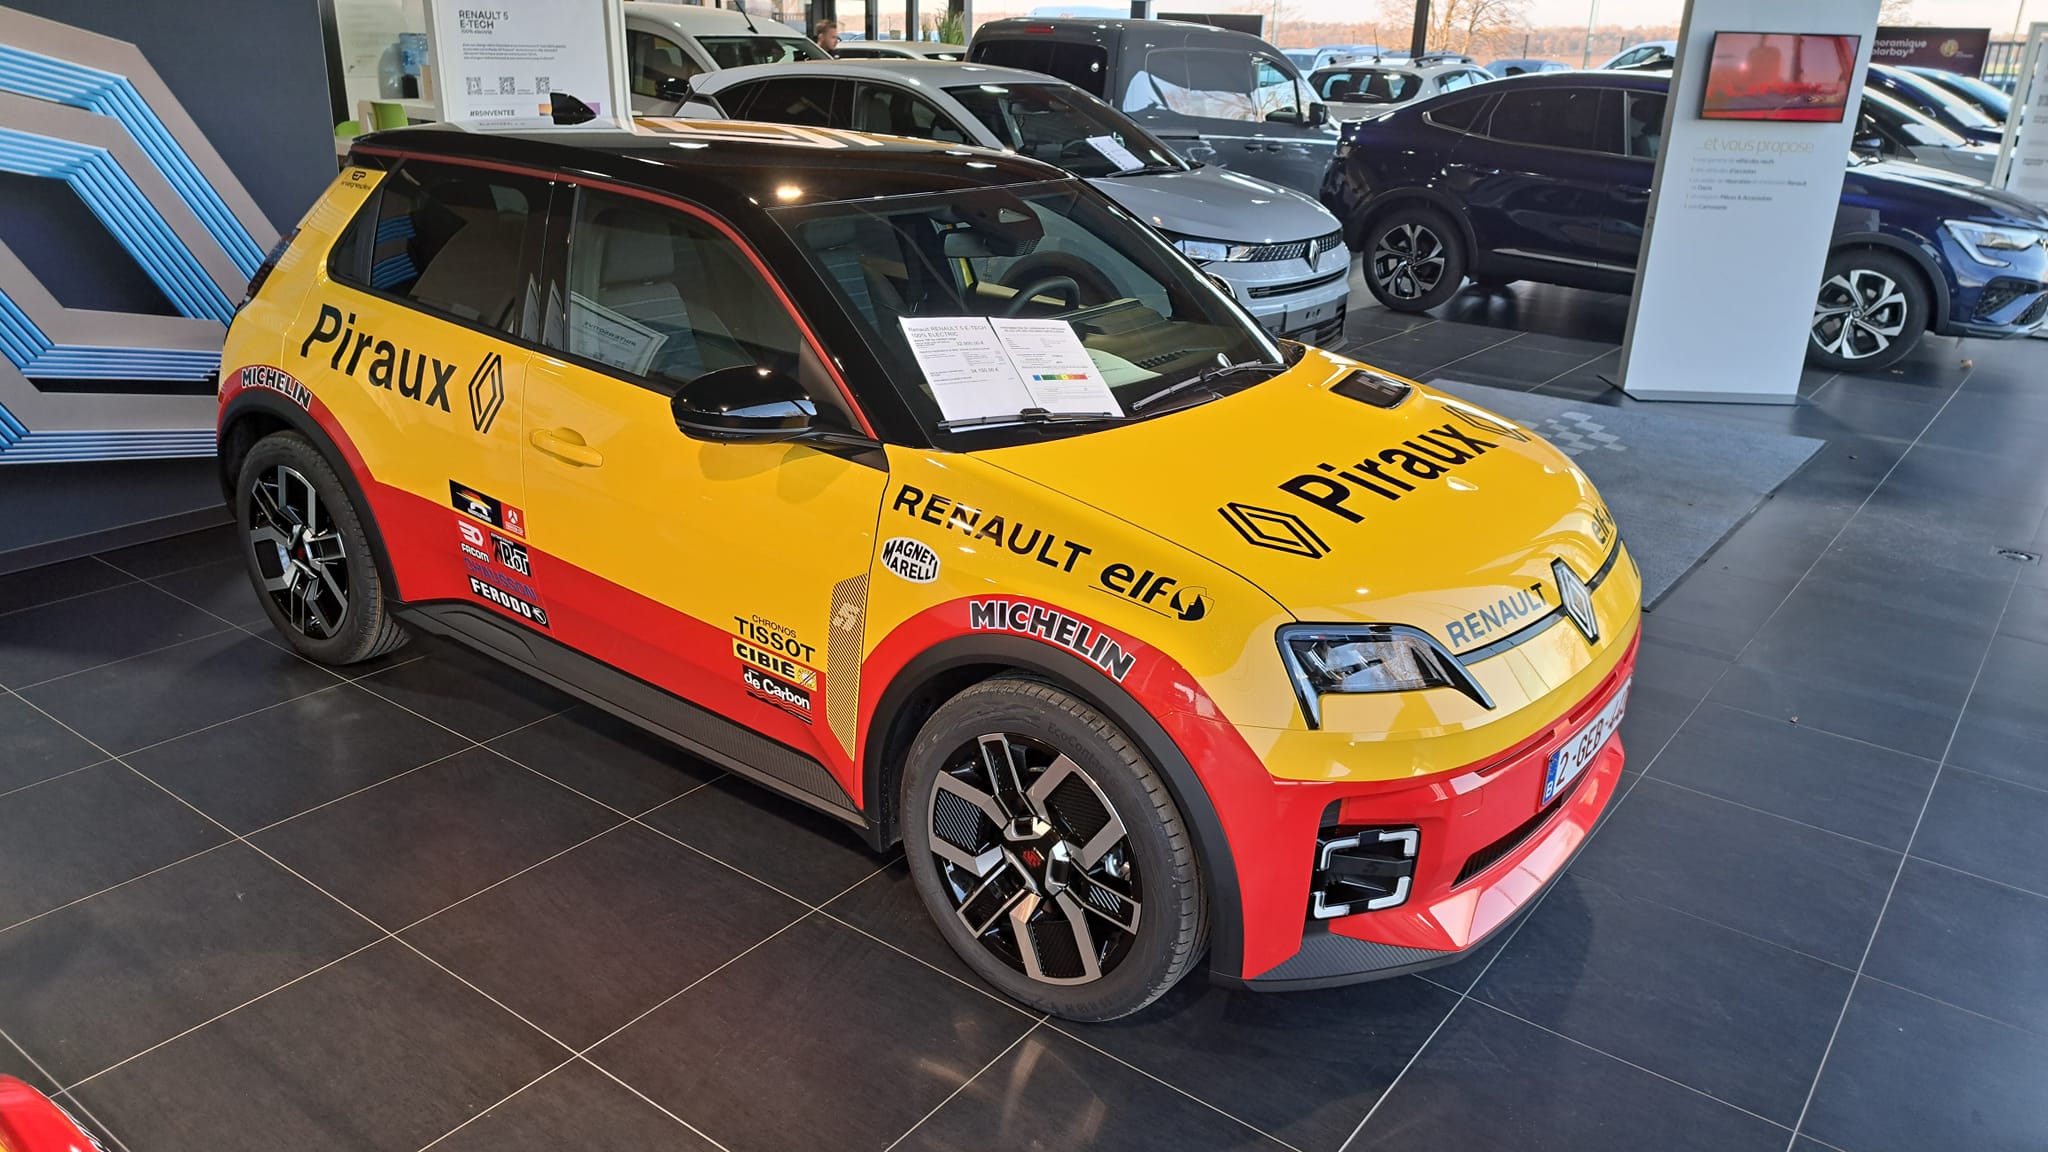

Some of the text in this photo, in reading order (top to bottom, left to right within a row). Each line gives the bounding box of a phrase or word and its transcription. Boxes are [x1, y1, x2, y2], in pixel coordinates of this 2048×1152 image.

[459, 9, 509, 20] RENAULT 5
[460, 19, 494, 29] E-TECH
[1720, 139, 1754, 152] vous
[1756, 140, 1815, 156] propose
[300, 303, 458, 413] Piraux
[241, 366, 312, 411] MICHELIN
[1278, 423, 1499, 524] Piraux
[893, 484, 1092, 573] RENAULT
[882, 540, 938, 572] MAGNETI
[882, 549, 938, 580] MARELLI
[470, 578, 532, 618] FERODO
[1100, 562, 1180, 604] elf
[752, 614, 796, 638] CHRONOS
[1445, 582, 1548, 648] RENAULT
[734, 616, 815, 662] TISSOT
[970, 600, 1136, 683] MICHELIN
[744, 669, 811, 710] de Carbon
[1556, 684, 1631, 786] 2-GEB-
